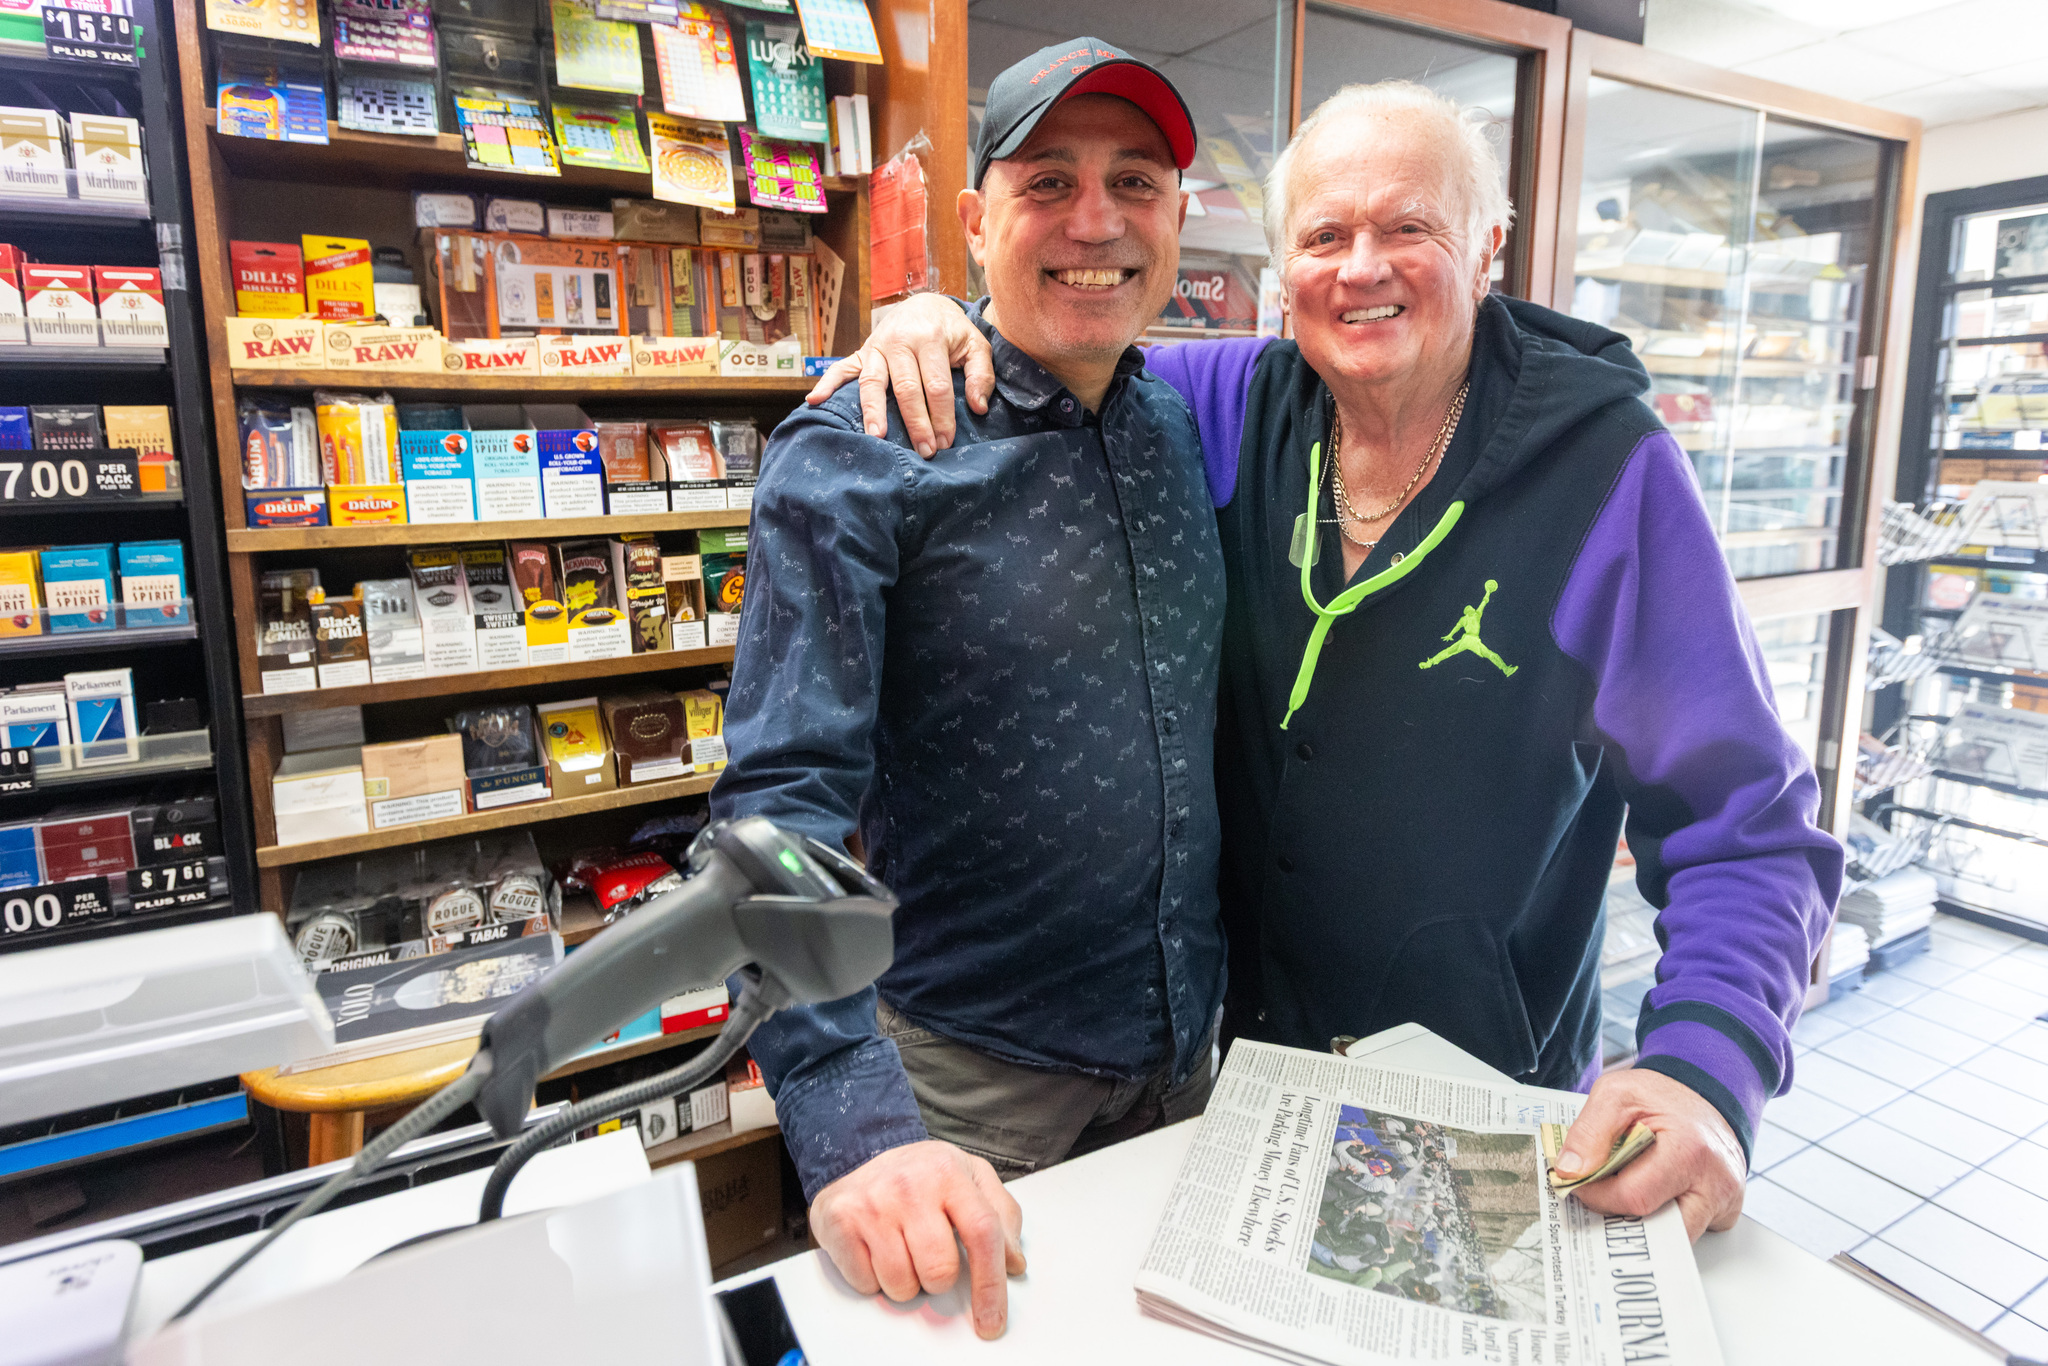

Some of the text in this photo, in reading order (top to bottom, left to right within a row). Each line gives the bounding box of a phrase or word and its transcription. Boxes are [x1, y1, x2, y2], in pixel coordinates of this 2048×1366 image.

[52, 45, 134, 63] PLUS TAX
[750, 39, 815, 67] LUCKY
[4, 162, 59, 185] Marlboro
[86, 169, 137, 191] Marlboro
[241, 270, 297, 285] DILL'S
[746, 266, 755, 293] OCB
[792, 266, 805, 298] RAW
[33, 311, 93, 335] Marlboro
[105, 313, 164, 336] Marlboro
[405, 332, 433, 341] TIPS
[243, 335, 315, 360] RAW
[353, 342, 418, 364] RAW
[558, 343, 624, 368] RAW
[651, 344, 707, 366] RAW
[463, 349, 527, 370] RAW
[730, 353, 769, 366] OCB
[42, 436, 94, 444] AMERICAN
[404, 445, 440, 454] SPIRIT
[475, 444, 508, 454] SPIRIT
[99, 463, 127, 474] PER
[249, 438, 265, 489] DRUM
[96, 474, 134, 485] PACK
[264, 501, 313, 514] DRUM
[348, 500, 393, 511] DRUM
[564, 556, 607, 575] ACKWOODS
[56, 596, 101, 608] SPIRIT
[133, 591, 174, 602] SPIRIT
[631, 590, 637, 598] 2
[630, 598, 654, 608] Straight
[269, 620, 311, 632] Black
[318, 615, 361, 629] Black
[482, 614, 518, 622] SWISHER
[486, 620, 518, 629] SWEETS
[277, 629, 312, 642] Mild
[328, 626, 363, 640] Mild
[71, 678, 123, 692] Parliament
[3, 704, 57, 716] Parliament
[688, 698, 712, 719] villiger
[1, 780, 32, 791] TAX
[494, 772, 537, 787] PUNCH
[74, 901, 100, 911] PACK
[75, 893, 95, 902] PER
[134, 892, 207, 910] PLUS TAX
[499, 892, 539, 908] ROGUE
[68, 906, 108, 918] PLUS TAX
[434, 902, 476, 922] ROGUE
[470, 926, 508, 945] TABAC
[336, 983, 375, 1028] YOLO
[1237, 1090, 1297, 1247] Are Parking Money Elsewhere
[1264, 1095, 1321, 1254] Longtime Fans of U.S. Stocks
[1548, 1202, 1568, 1328] Rival Spurs Protests in Turkey
[1611, 1268, 1671, 1366] JOURNA
[1462, 1320, 1479, 1356] Tariffs
[1480, 1325, 1502, 1353] April
[1530, 1329, 1548, 1366] House
[1554, 1331, 1572, 1366] White
